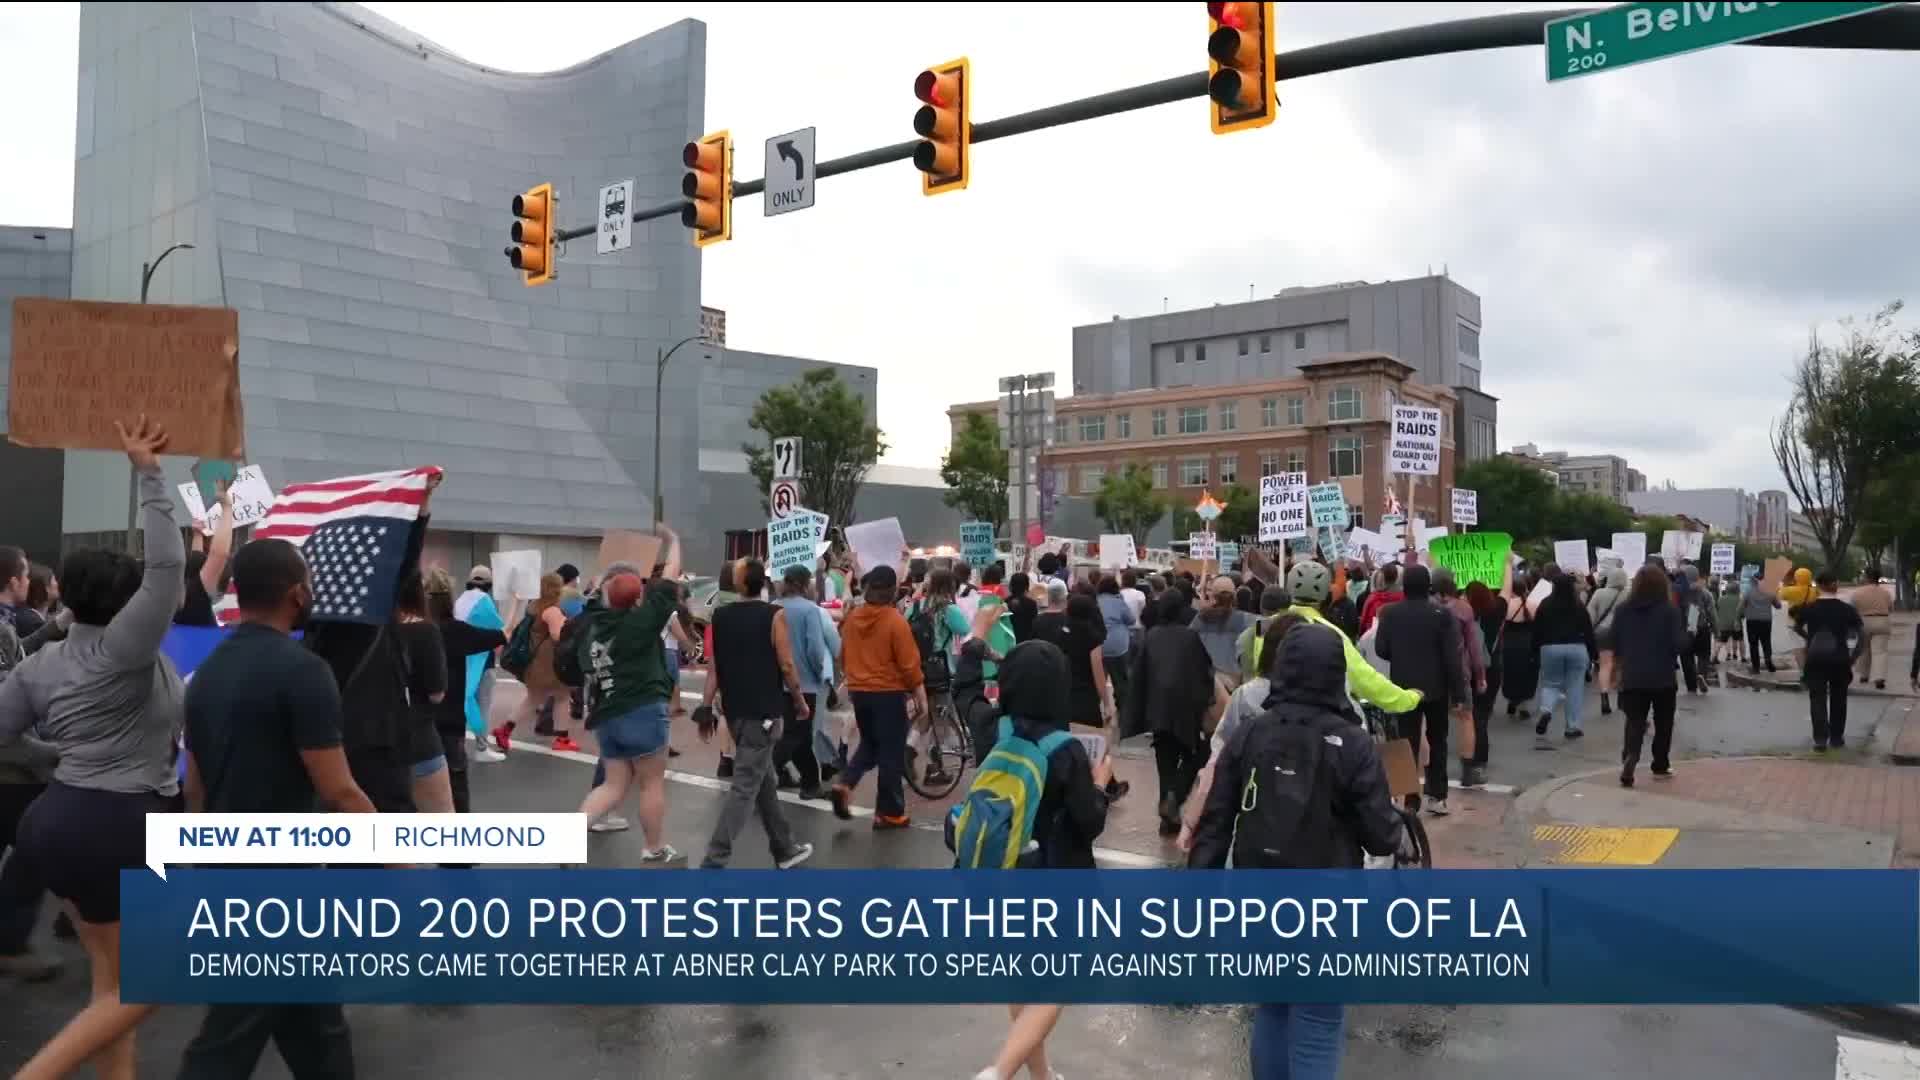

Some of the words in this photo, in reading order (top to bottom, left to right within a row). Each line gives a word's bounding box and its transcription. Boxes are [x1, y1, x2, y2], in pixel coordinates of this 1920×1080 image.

[1566, 22, 1604, 53] N.
[1568, 52, 1606, 73] 200
[773, 186, 805, 207] ONLY
[603, 219, 624, 232] ONLY
[1396, 409, 1419, 419] STOP
[1422, 410, 1439, 420] THE
[1397, 421, 1436, 437] RAIDS
[1396, 440, 1434, 451] NATIONAL
[1393, 450, 1420, 460] GUARD
[1422, 453, 1437, 462] OUT
[1401, 460, 1411, 469] OF
[1263, 474, 1303, 489] POWER
[1262, 490, 1304, 506] PEOPLE
[1312, 493, 1340, 503] RAIDS
[1261, 511, 1276, 523] NO
[1280, 508, 1304, 521] ONE
[771, 521, 791, 532] STOP
[1261, 526, 1269, 536] IS
[1272, 523, 1304, 535] ILLEGAL
[772, 528, 809, 546] RAIDS
[963, 534, 991, 544] RAIDS
[799, 552, 814, 562] OUT
